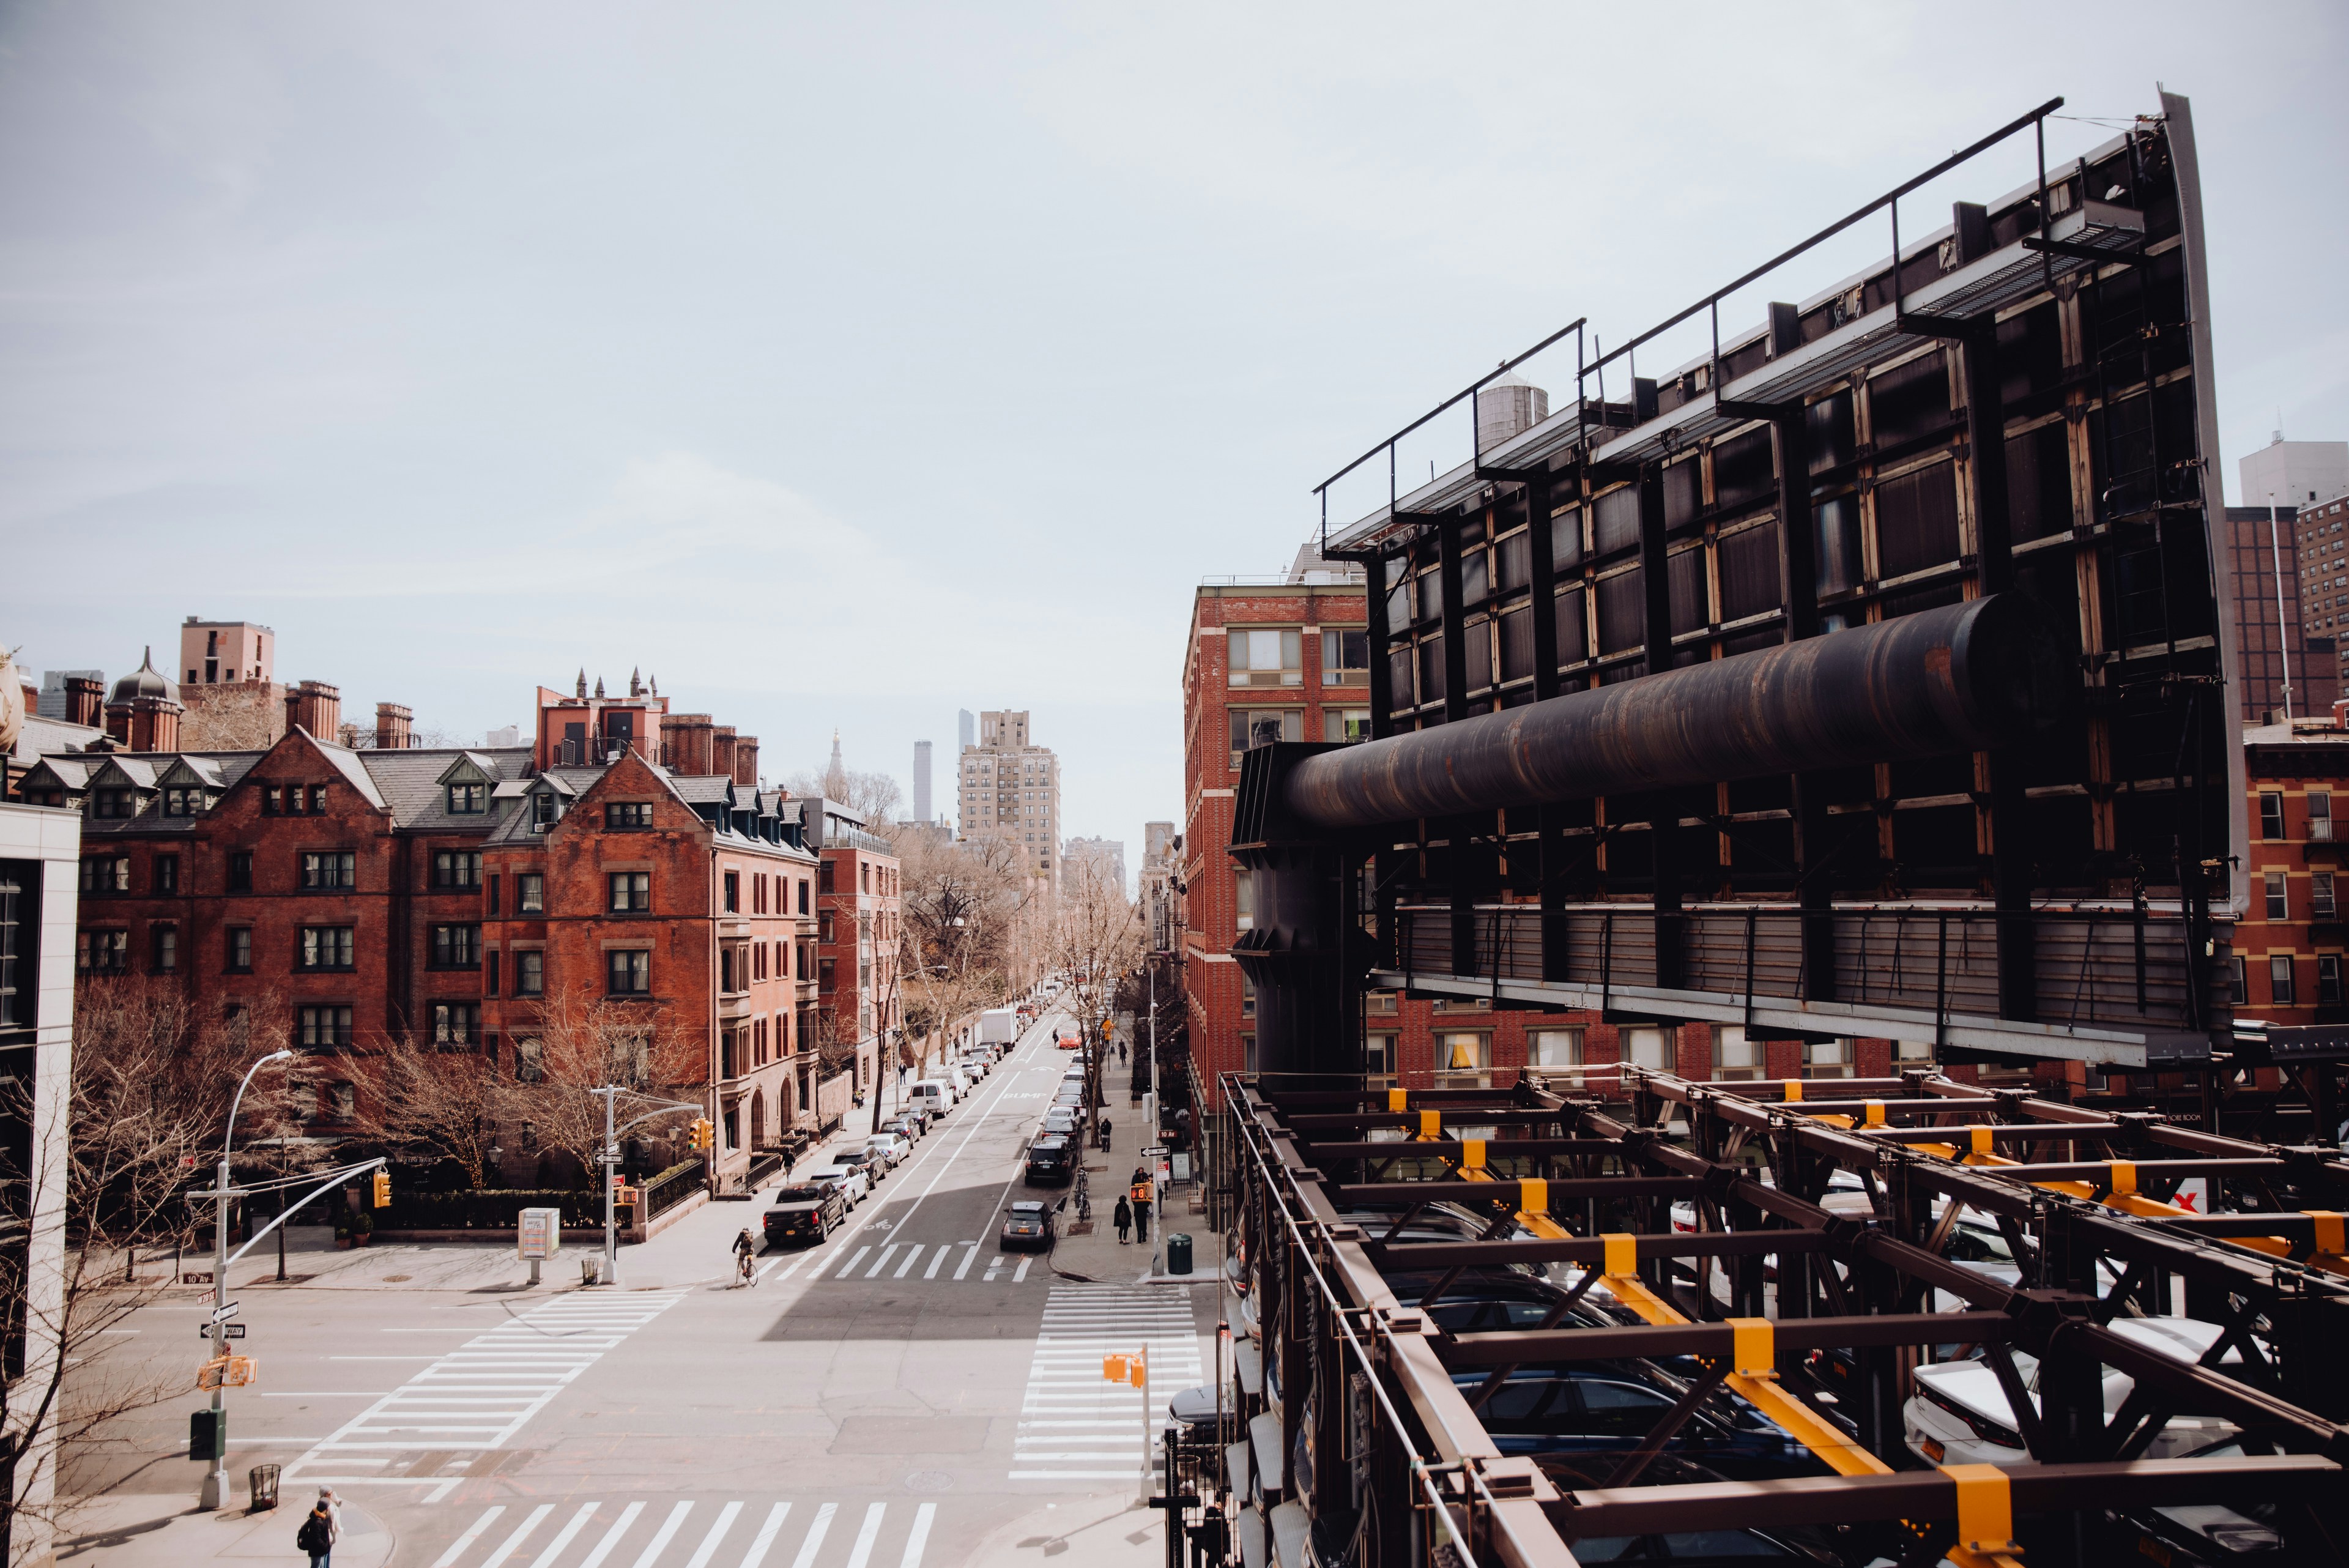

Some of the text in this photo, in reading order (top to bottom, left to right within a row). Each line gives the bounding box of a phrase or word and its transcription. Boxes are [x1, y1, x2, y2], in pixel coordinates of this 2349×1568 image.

[198, 1291, 215, 1305] W 20 St
